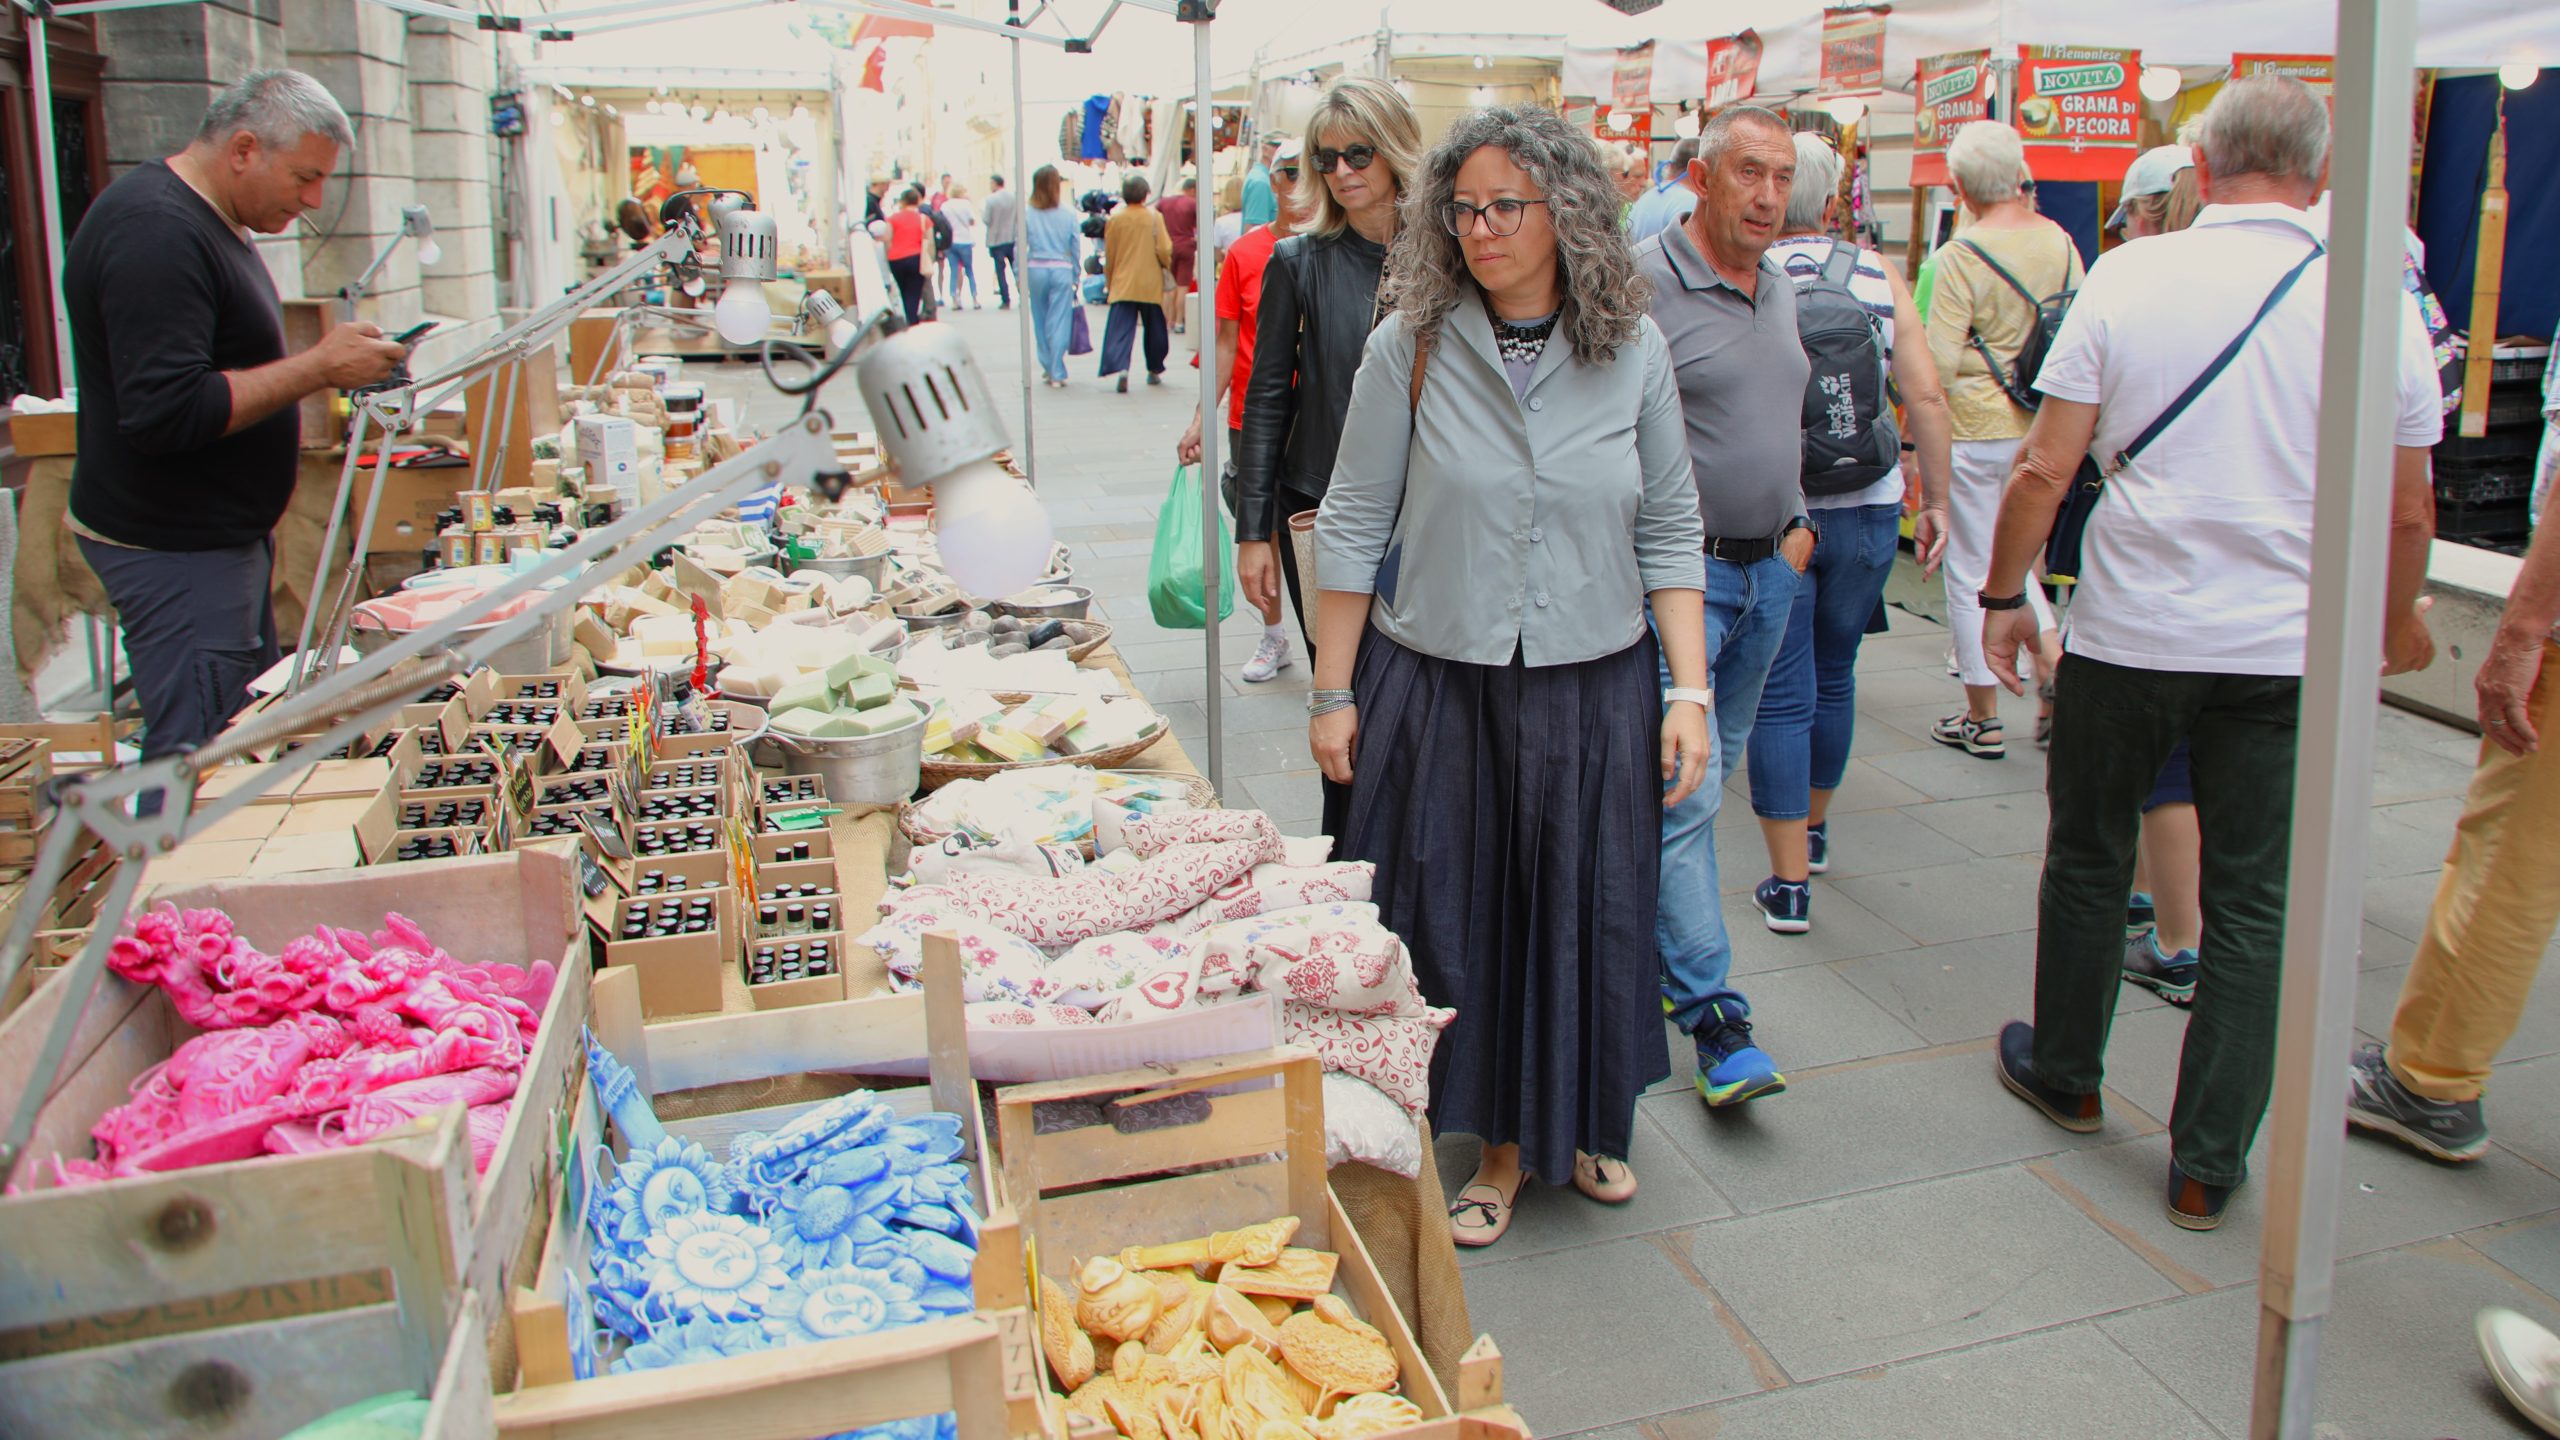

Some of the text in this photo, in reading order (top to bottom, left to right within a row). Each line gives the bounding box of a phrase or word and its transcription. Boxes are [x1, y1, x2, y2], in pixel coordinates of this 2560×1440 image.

[2042, 44, 2121, 61] Il Piemontese
[1937, 100, 1984, 120] GRANA DI
[2061, 95, 2136, 114] GRANA DI
[2064, 116, 2131, 136] PECORA
[1839, 373, 1857, 439] Wolfskin
[1826, 402, 1843, 439] Jack
